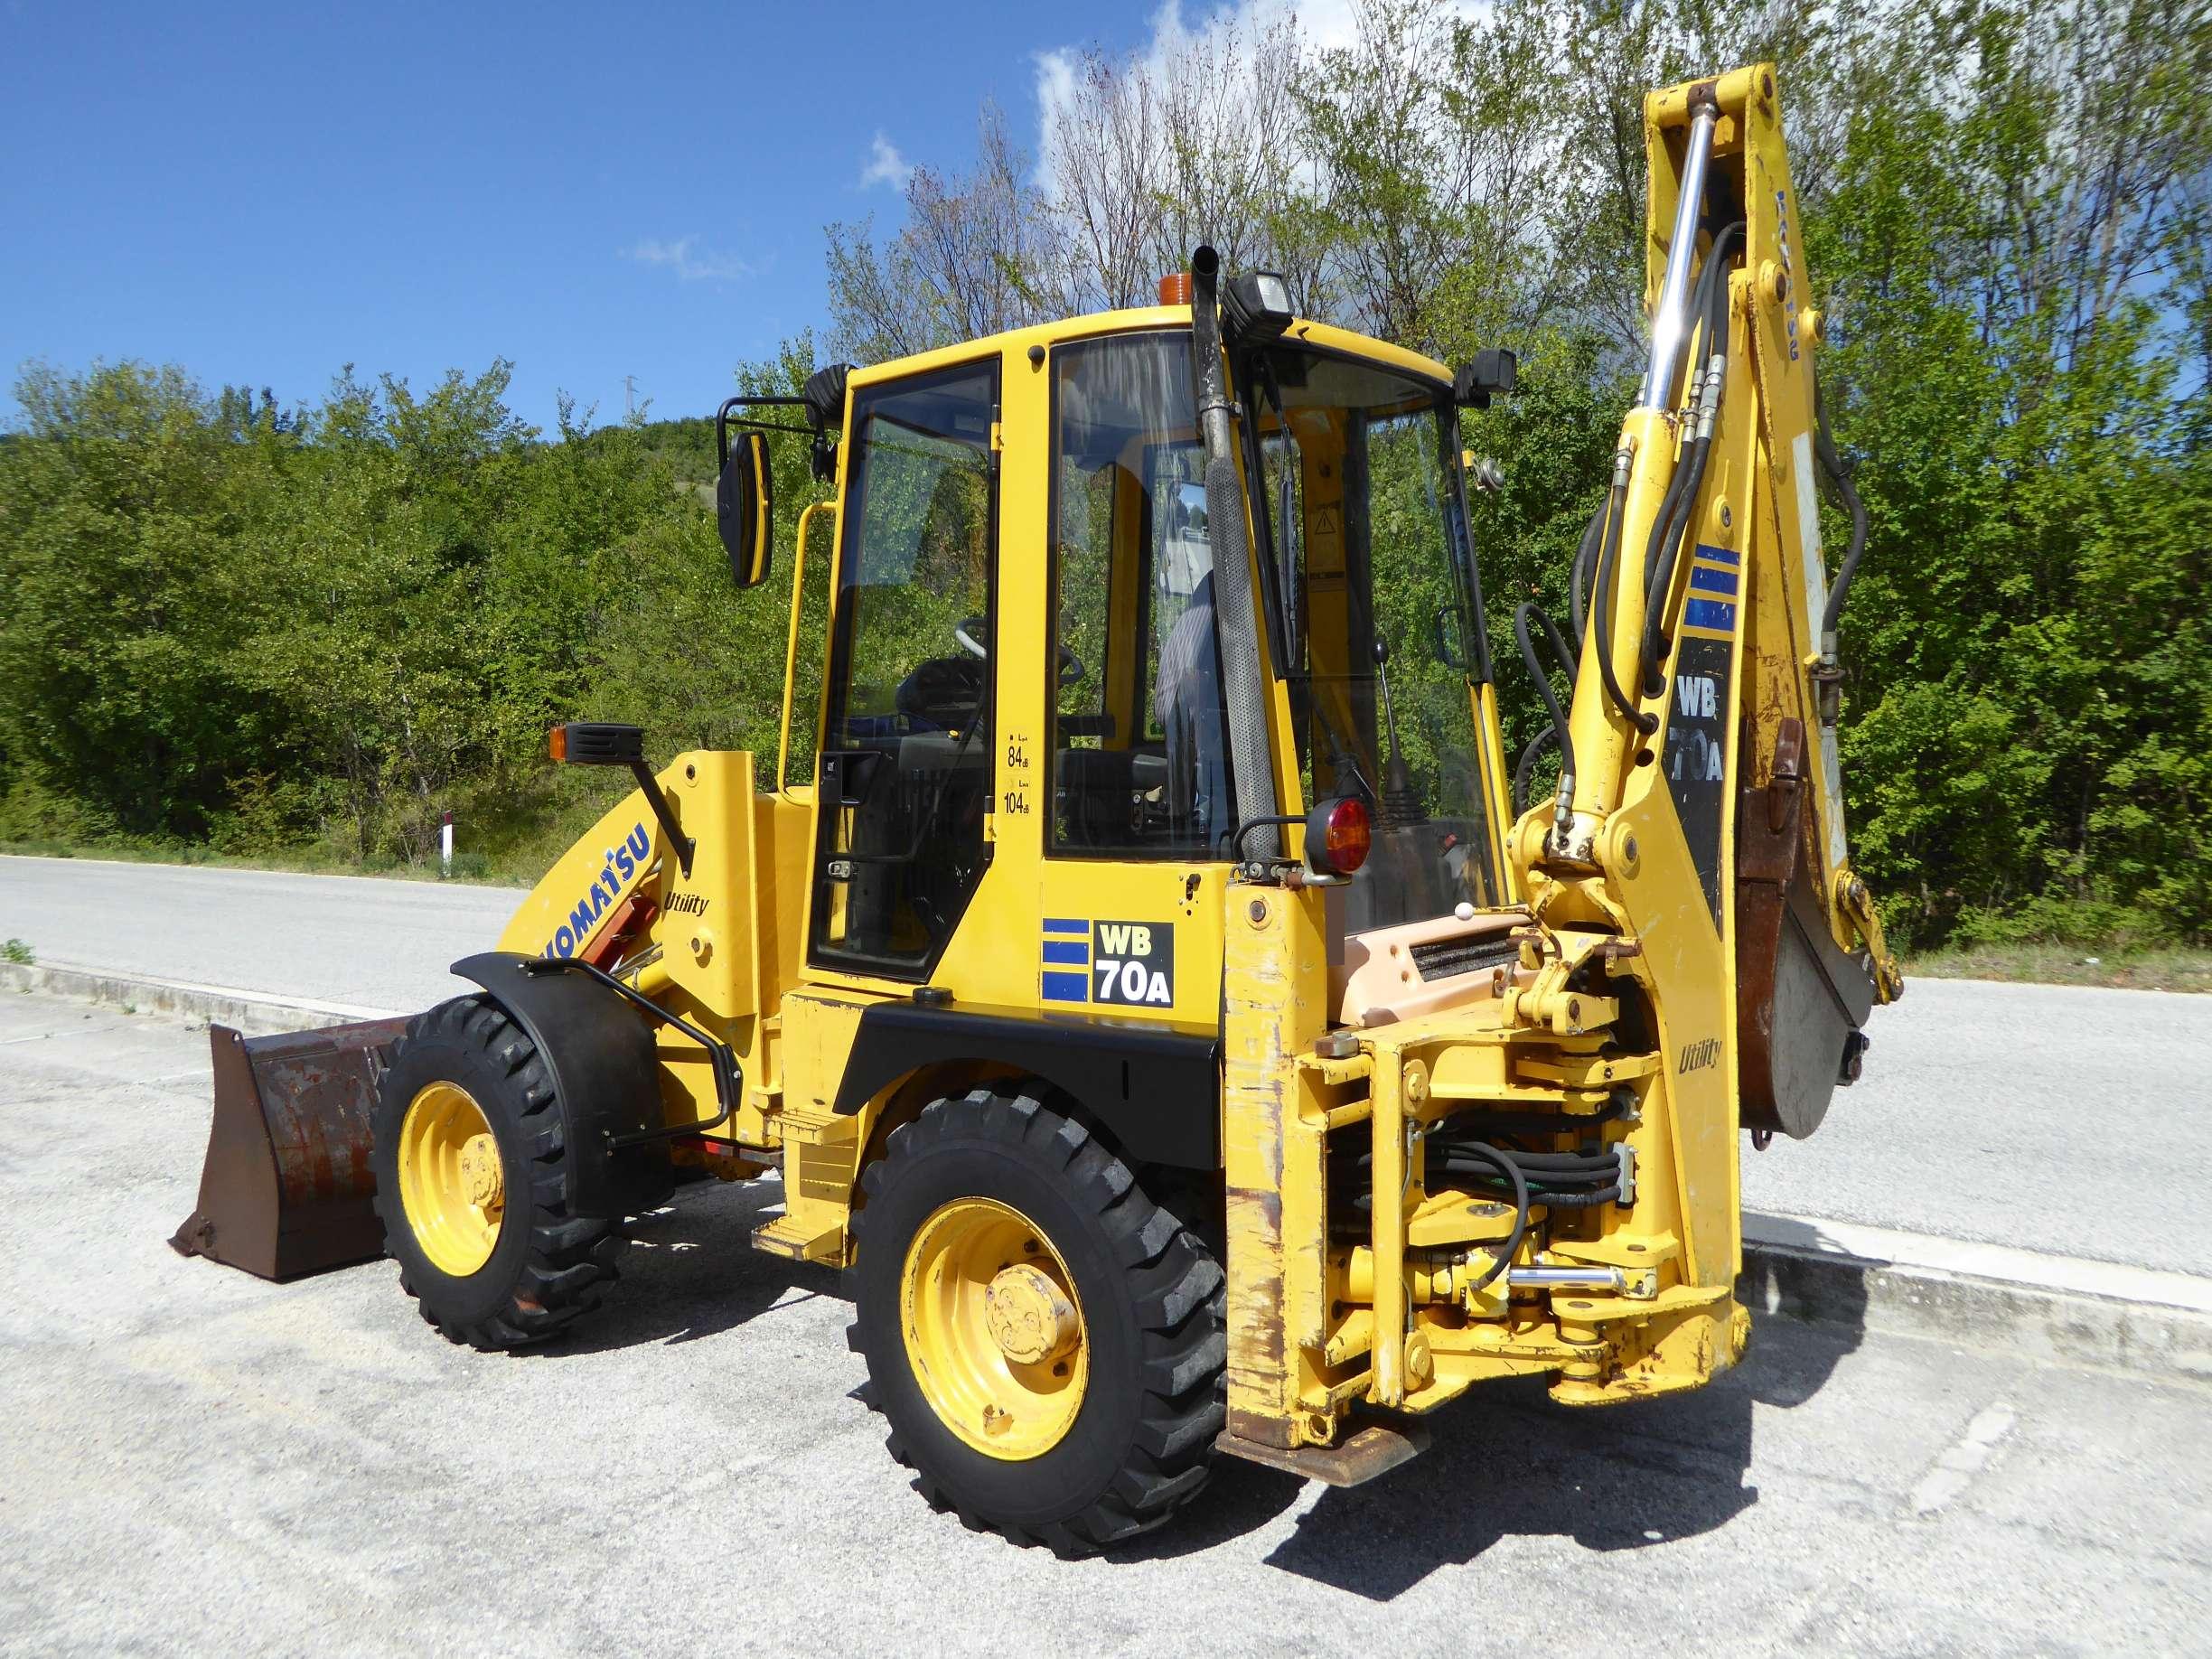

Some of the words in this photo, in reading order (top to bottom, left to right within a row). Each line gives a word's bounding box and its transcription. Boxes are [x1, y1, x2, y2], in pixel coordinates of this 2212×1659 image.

[1677, 675, 1716, 717] WB
[664, 891, 710, 916] Utility
[1100, 924, 1152, 956] WB
[1096, 960, 1171, 1002] 70A
[1679, 1038, 1722, 1074] Utility
